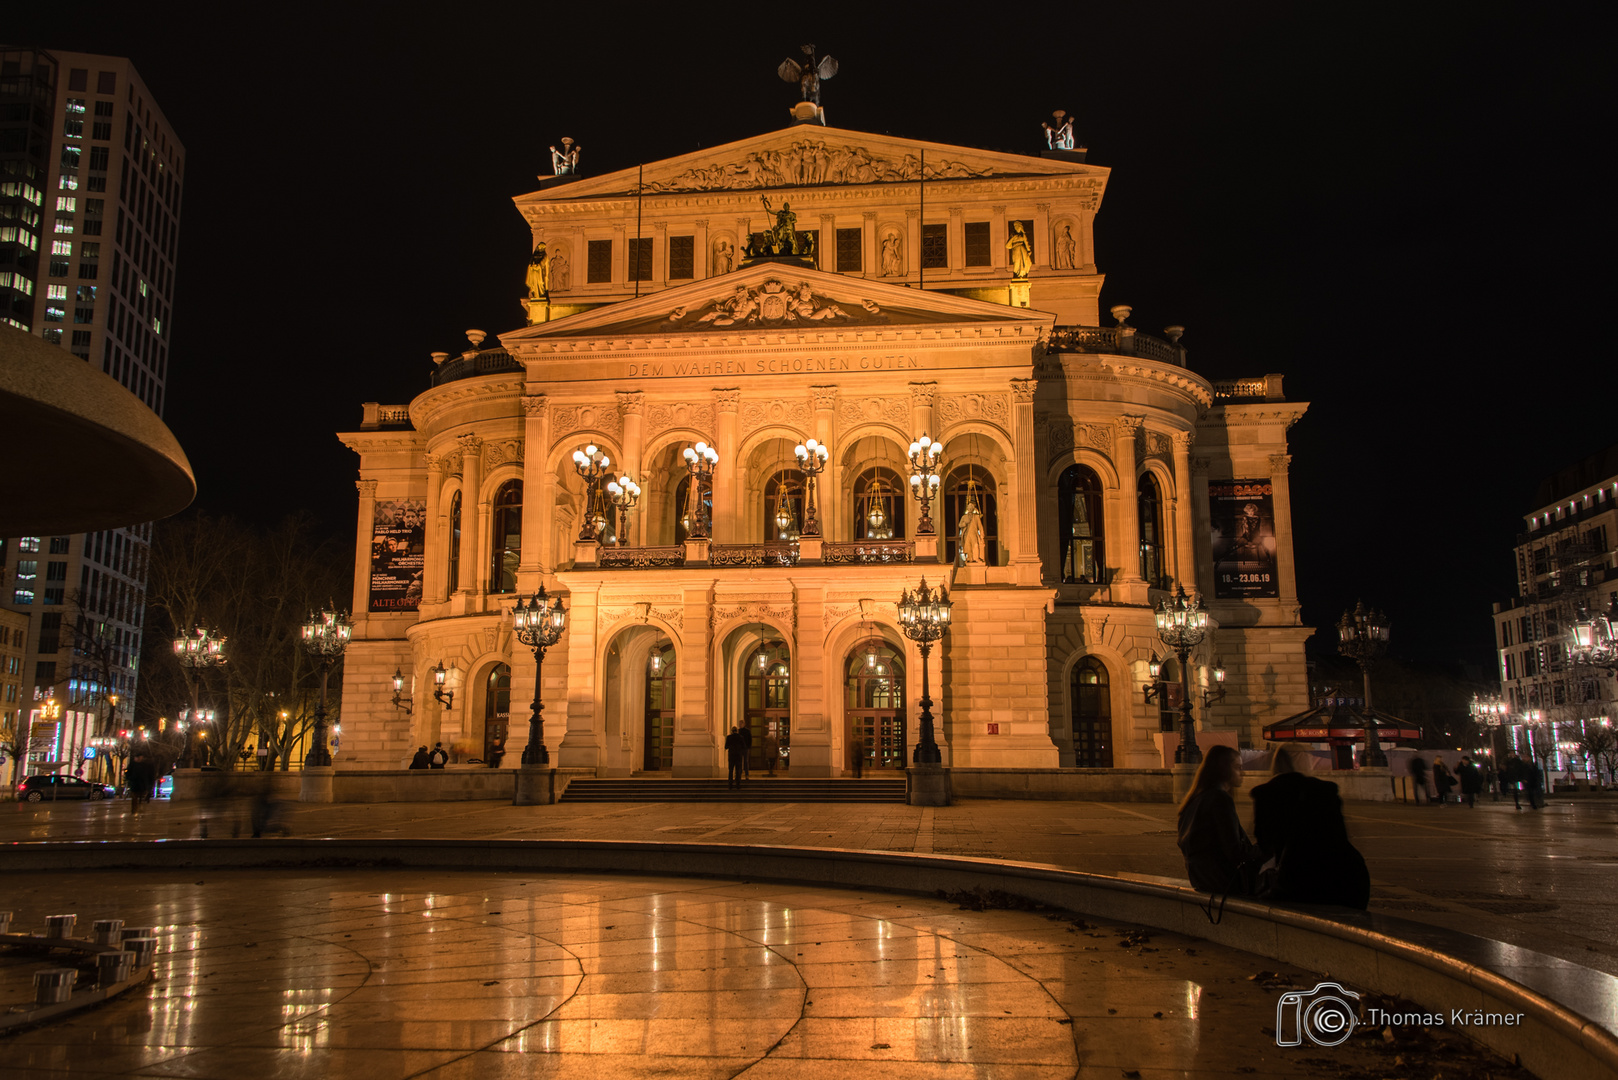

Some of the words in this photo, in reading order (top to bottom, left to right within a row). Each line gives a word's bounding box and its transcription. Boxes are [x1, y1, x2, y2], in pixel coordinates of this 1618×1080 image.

[629, 363, 664, 377] DEM
[673, 361, 746, 376] WAHREN
[757, 358, 850, 373] SCHOENEN
[1208, 484, 1272, 497] CHICAGO
[372, 599, 395, 607] ALTE
[396, 598, 421, 607] OPER
